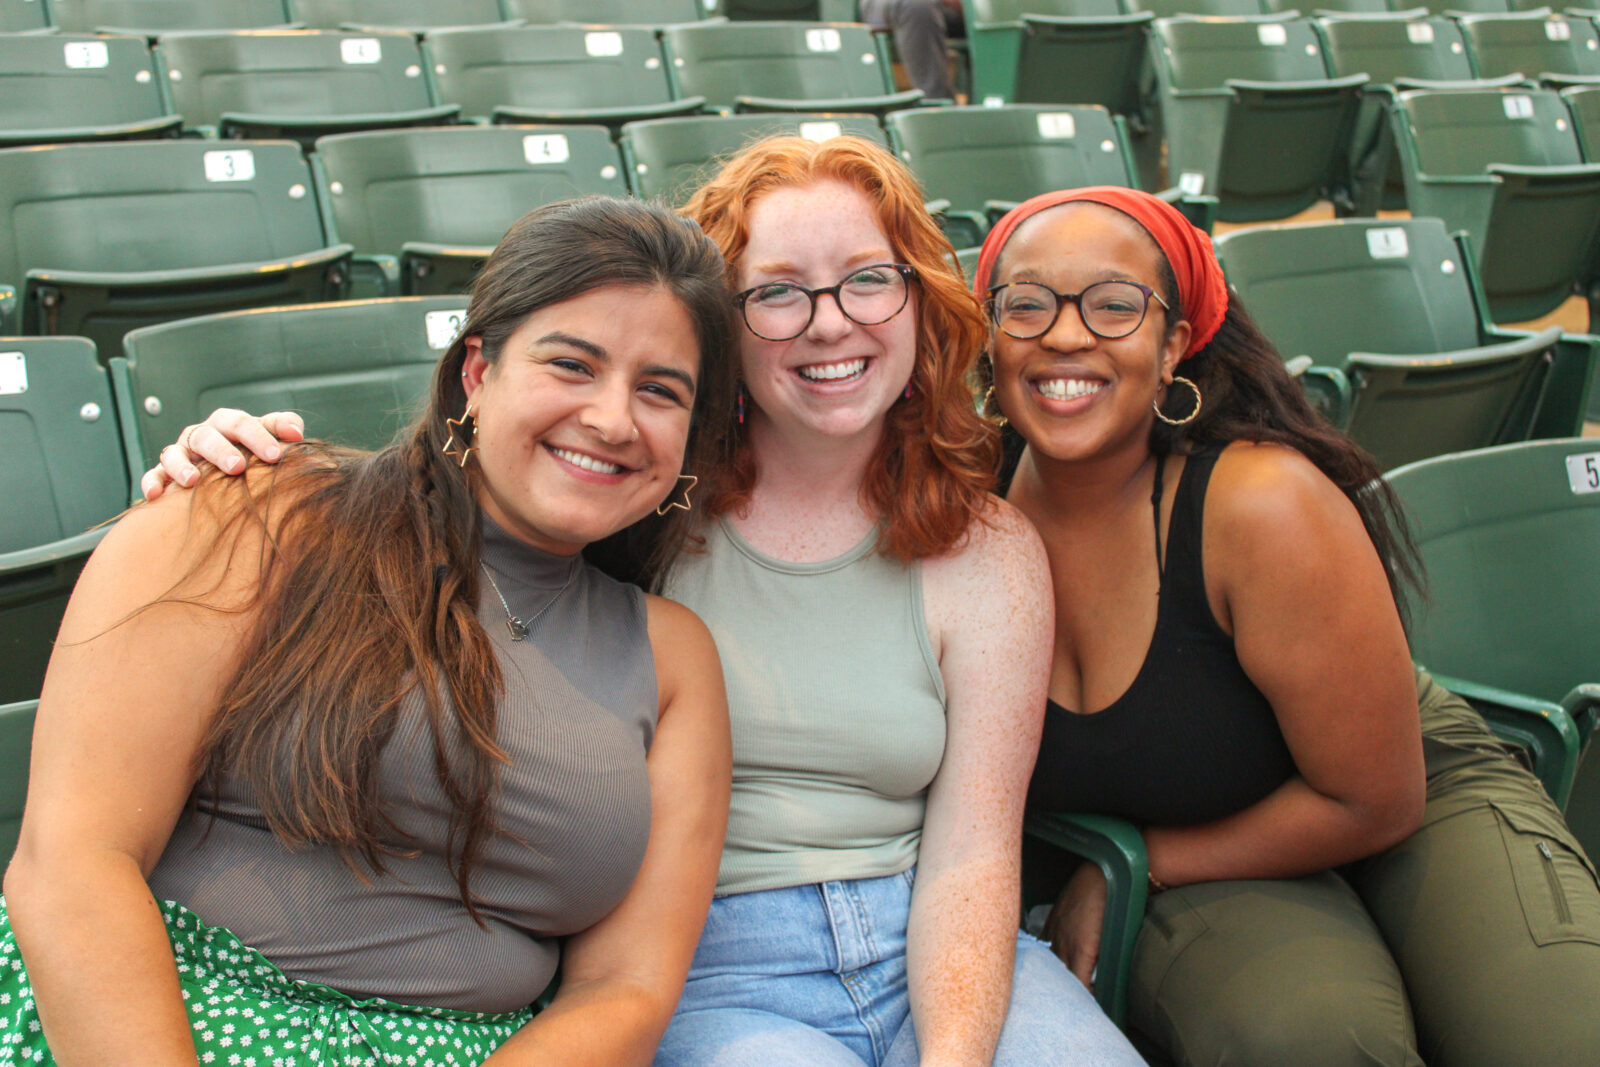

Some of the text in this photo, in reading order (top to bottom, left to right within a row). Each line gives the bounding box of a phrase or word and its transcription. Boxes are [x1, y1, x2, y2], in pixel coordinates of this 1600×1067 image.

[541, 139, 551, 158] 4
[224, 154, 235, 178] 3
[1585, 457, 1599, 488] 5
